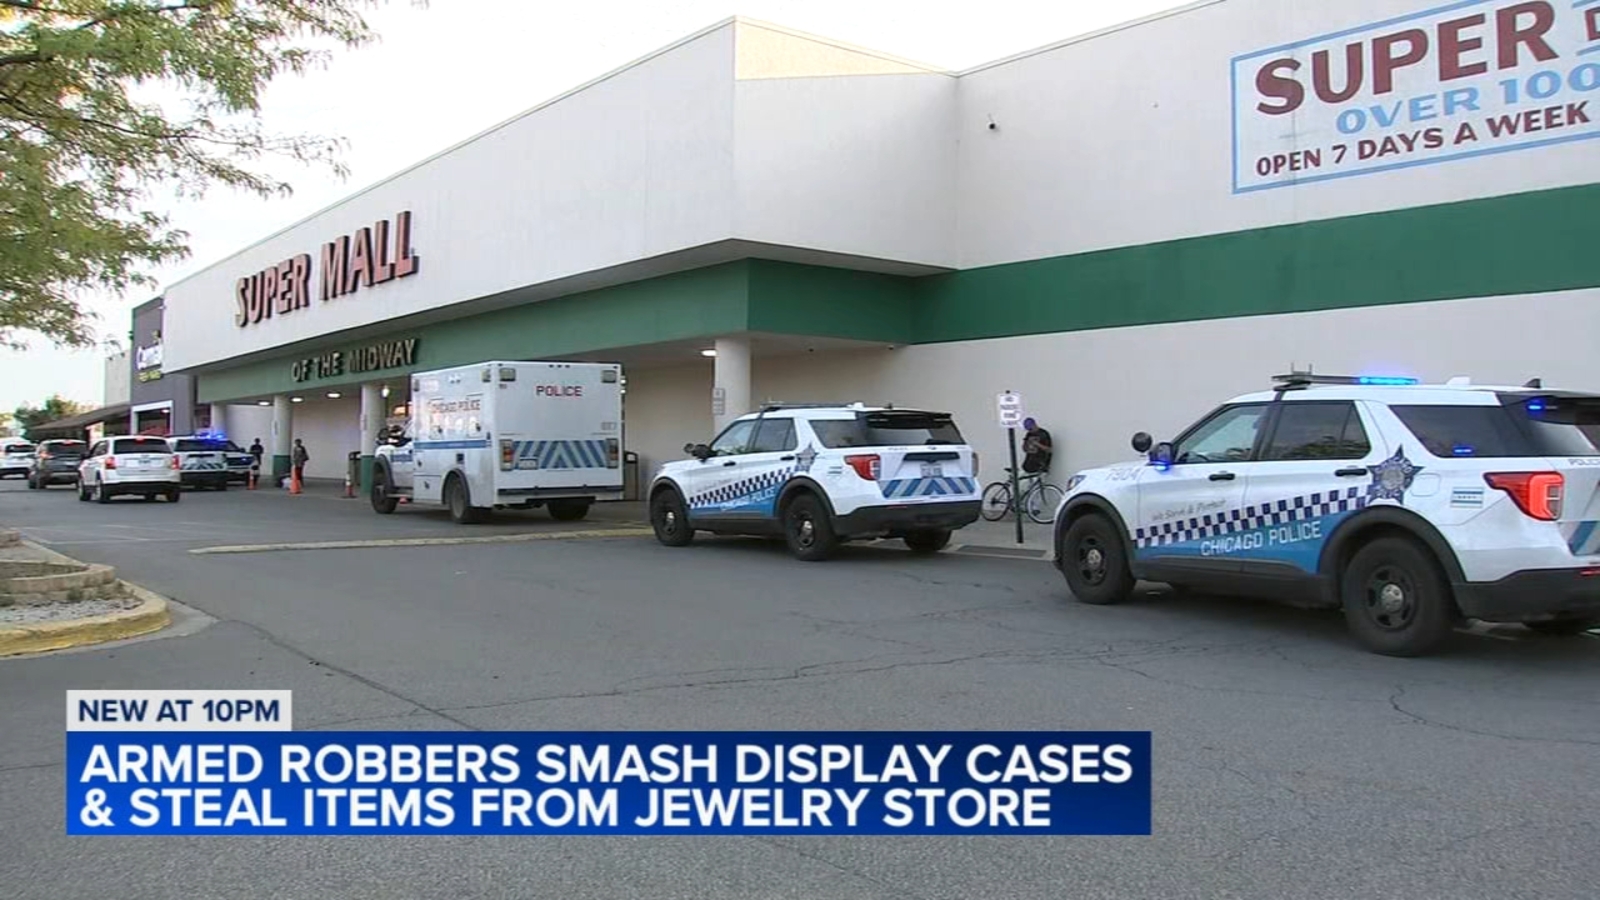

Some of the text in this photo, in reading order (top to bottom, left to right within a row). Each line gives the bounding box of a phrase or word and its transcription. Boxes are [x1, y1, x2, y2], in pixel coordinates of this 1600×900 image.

[1255, 0, 1558, 115] SUPER
[1336, 87, 1480, 135] OVER
[1256, 100, 1591, 176] OPEN 7 DAYS A WEEK
[235, 210, 419, 328] SUPER MALL
[291, 338, 418, 381] OF THE MIDWAY
[536, 385, 583, 397] POLICE
[1200, 521, 1322, 556] CHICAGO POLICE
